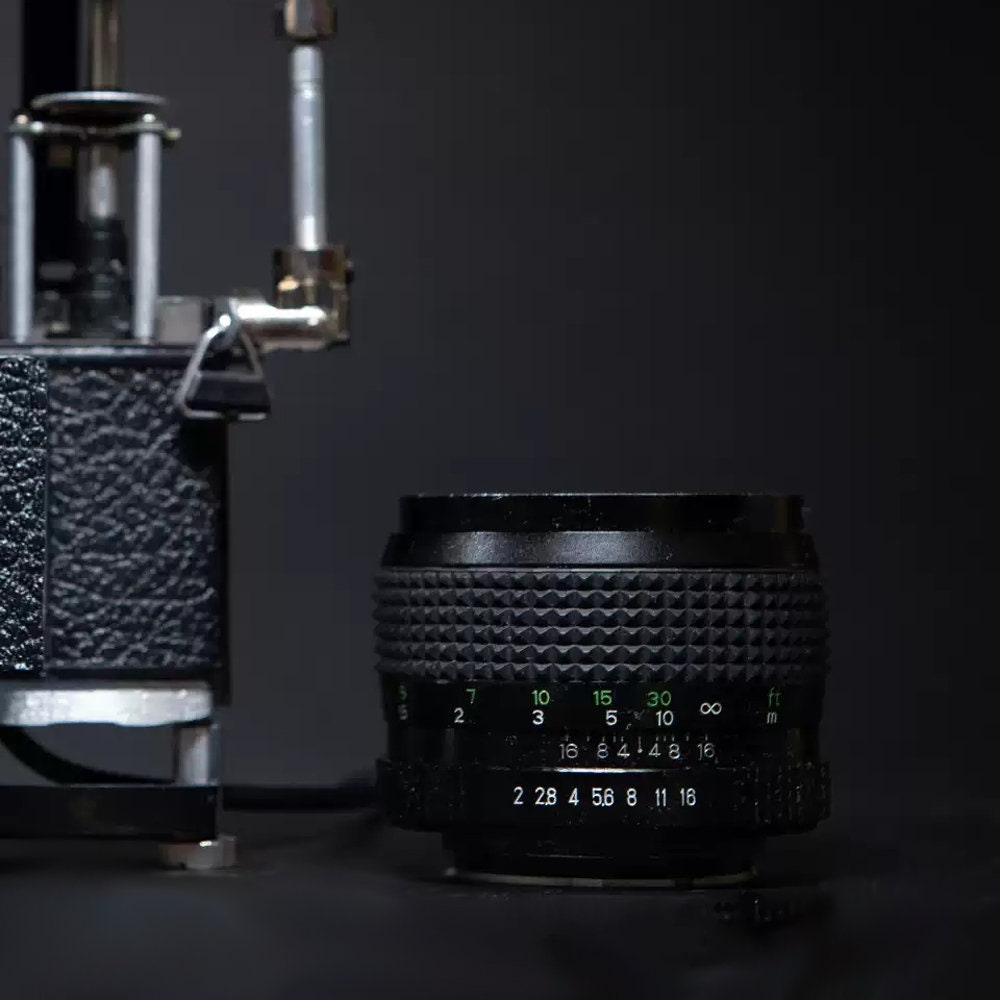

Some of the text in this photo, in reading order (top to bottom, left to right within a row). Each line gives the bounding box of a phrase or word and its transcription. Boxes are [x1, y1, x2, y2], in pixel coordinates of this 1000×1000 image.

[464, 688, 477, 706] 7
[531, 689, 551, 706] 10
[592, 689, 614, 707] 15
[646, 690, 673, 708] 30
[453, 706, 466, 724] 2
[532, 709, 545, 726] 3
[605, 709, 618, 726] 5
[655, 709, 675, 727] 10
[766, 711, 778, 725] m
[559, 742, 717, 761] 16 8 4 4 8 16
[513, 785, 524, 806] 2
[567, 787, 580, 807] 4
[625, 787, 639, 808] 8
[654, 787, 668, 808] 11
[679, 787, 697, 808] 16
